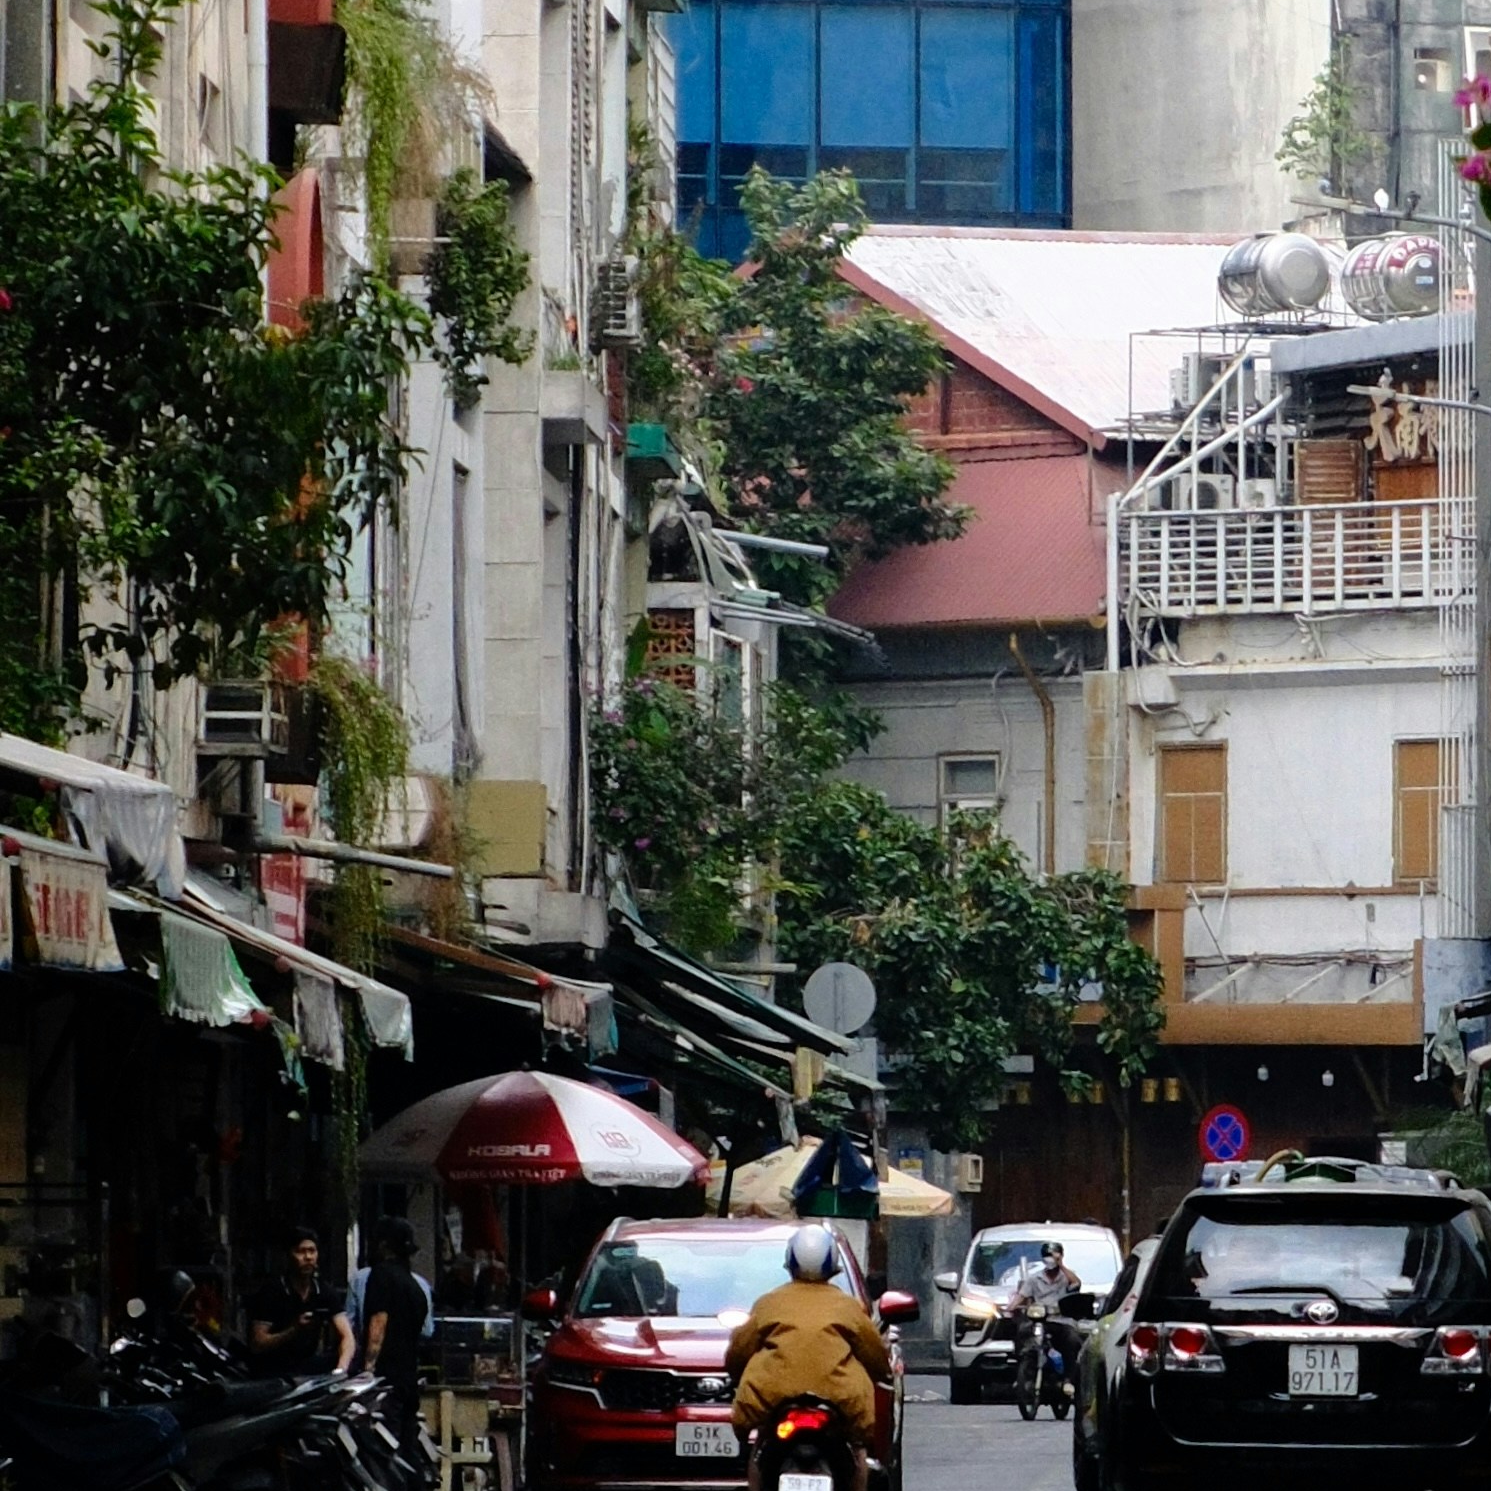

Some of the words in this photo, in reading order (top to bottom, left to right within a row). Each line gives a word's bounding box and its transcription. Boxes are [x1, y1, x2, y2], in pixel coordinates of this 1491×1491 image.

[467, 1144, 551, 1157] KOSALA
[1305, 1349, 1341, 1369] 51A
[1291, 1372, 1354, 1392] 971.17
[694, 1427, 720, 1439] 61K
